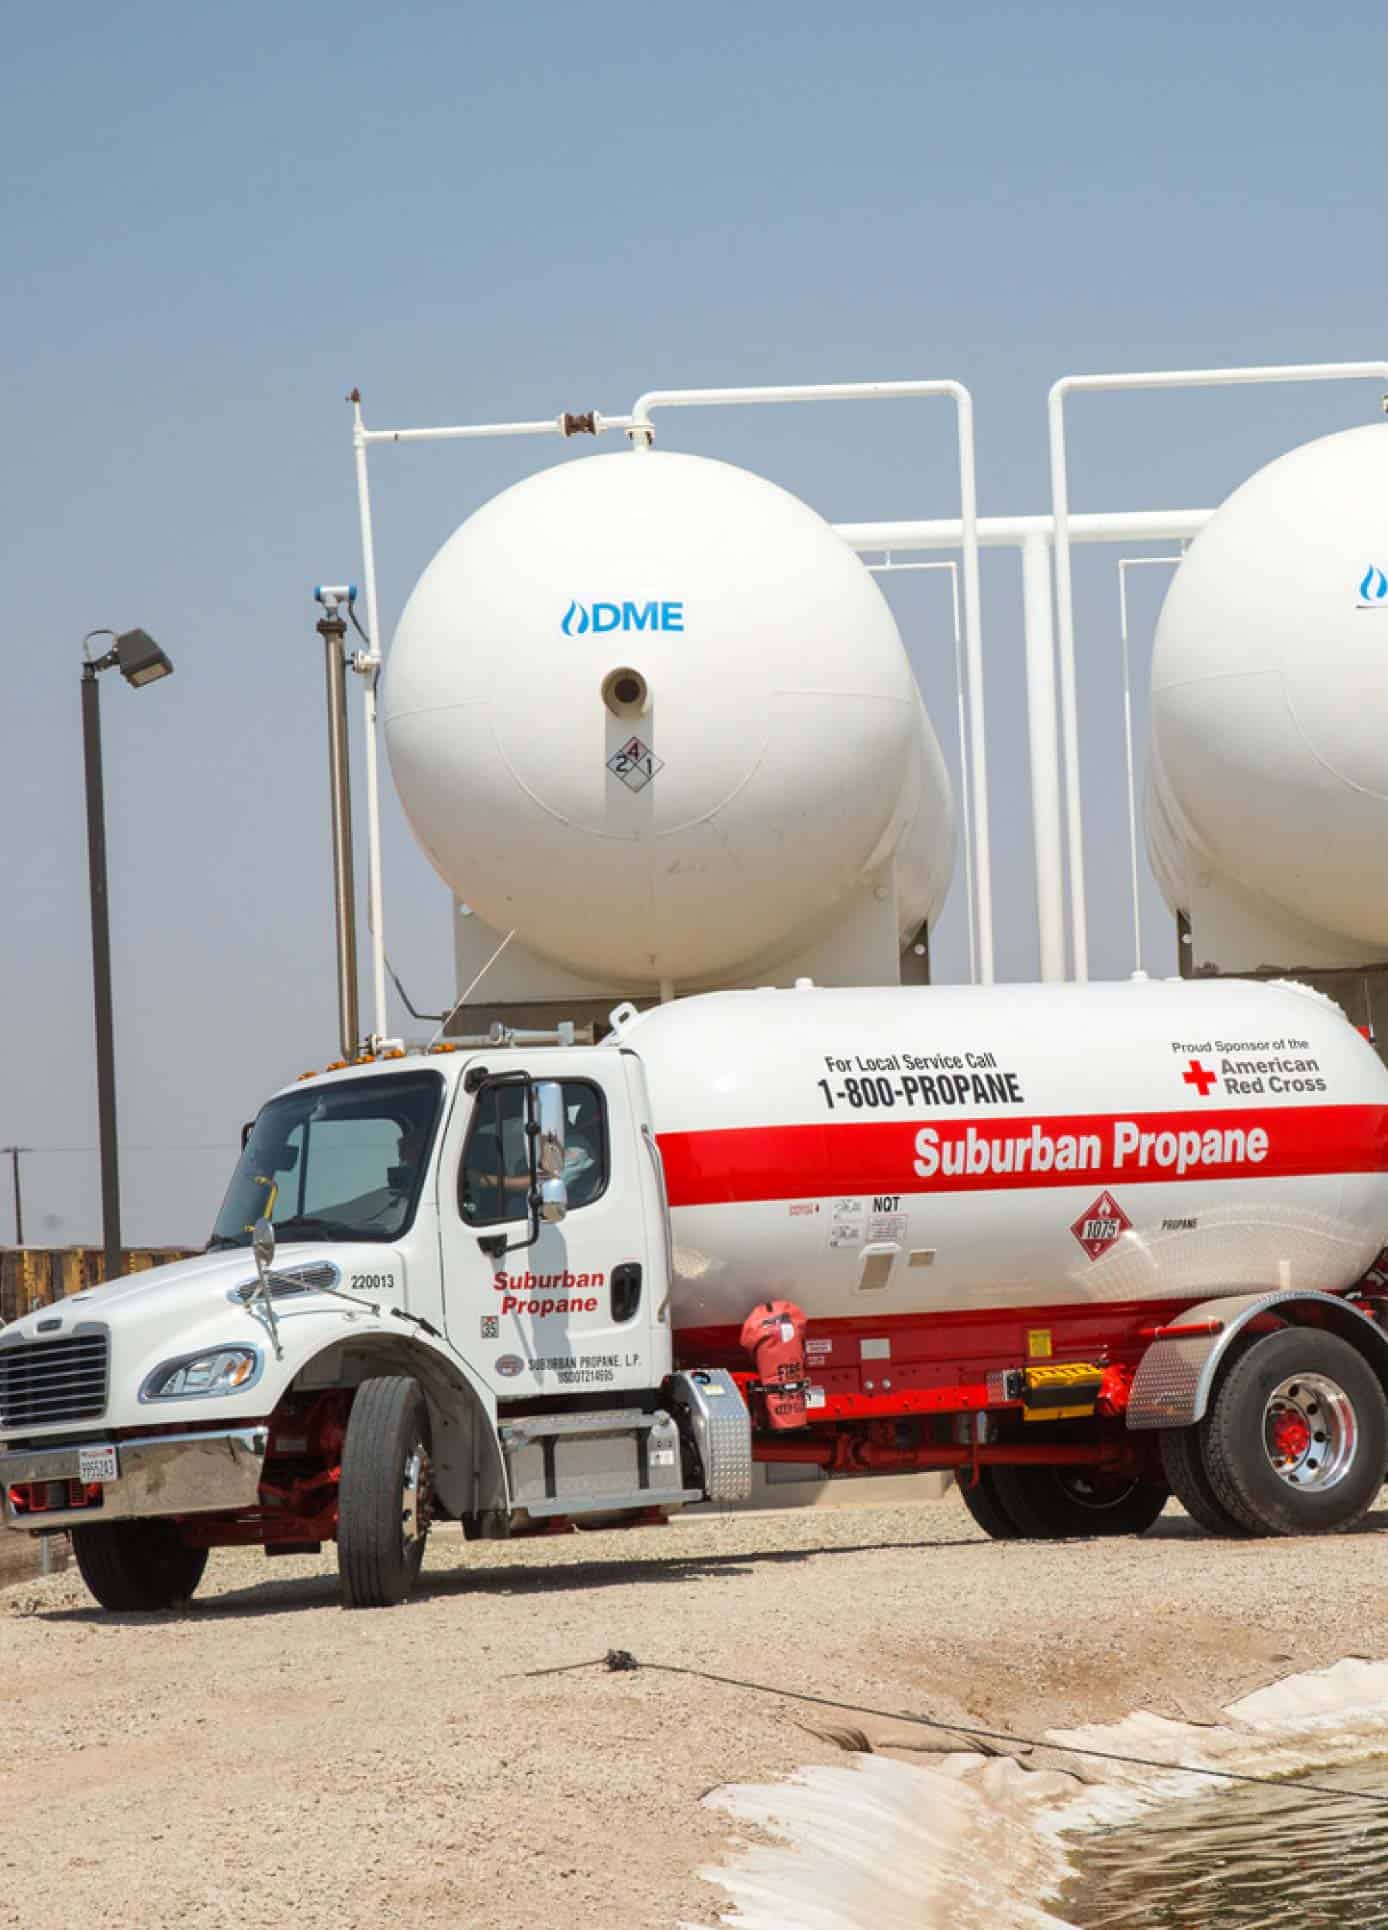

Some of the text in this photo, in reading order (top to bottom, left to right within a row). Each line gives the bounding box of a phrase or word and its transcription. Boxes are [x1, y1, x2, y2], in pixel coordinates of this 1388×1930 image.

[592, 601, 684, 633] DME
[627, 742, 640, 760] 4
[615, 753, 629, 772] 2
[646, 757, 652, 774] 1
[1172, 1038, 1309, 1054] Proud Sponsor of the
[824, 1051, 997, 1073] For Local Service Call
[1221, 1057, 1320, 1075] American
[817, 1072, 1025, 1110] 1-800-PROPANE
[1223, 1076, 1327, 1094] Red Cross
[913, 1121, 1269, 1177] Suburban Propane
[1086, 1220, 1118, 1238] 1075
[1161, 1218, 1199, 1230] PROPANE
[351, 1274, 394, 1289] 220013
[494, 1270, 605, 1290] Suburban
[501, 1296, 598, 1317] Propane
[528, 1357, 576, 1371] SUBURBAN
